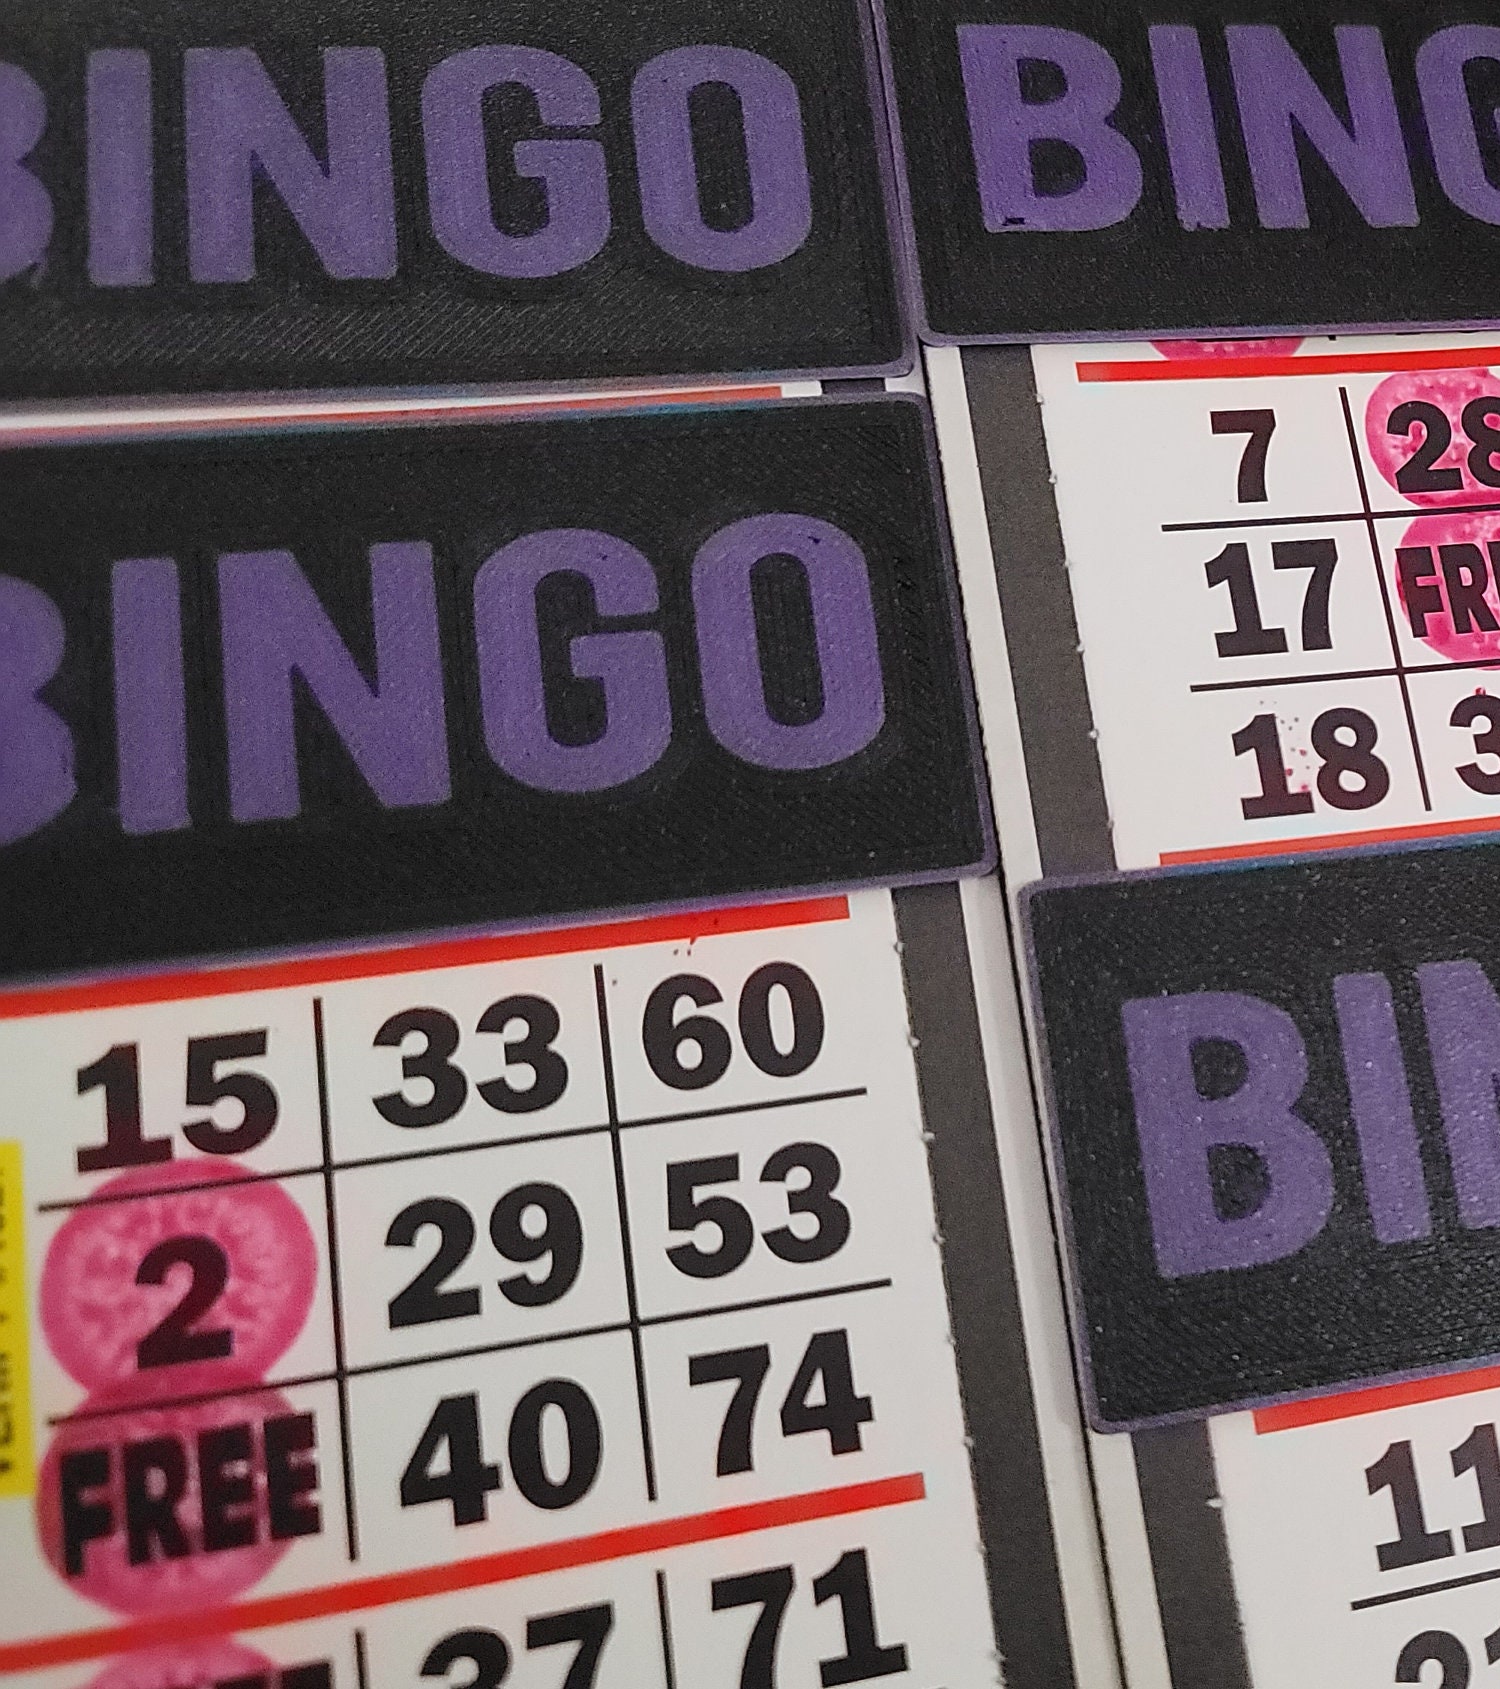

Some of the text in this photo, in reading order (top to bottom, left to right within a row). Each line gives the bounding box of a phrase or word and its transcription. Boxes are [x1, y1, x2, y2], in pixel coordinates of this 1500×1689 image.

[1211, 408, 1277, 503] 7
[1204, 538, 1338, 658] 17
[1230, 707, 1391, 820] 18
[75, 961, 825, 1173] 15 33 60
[135, 1234, 234, 1370] 2
[385, 1181, 584, 1329] 29
[666, 1142, 852, 1279] 53
[59, 1329, 874, 1579] FREE 40 74
[710, 1548, 910, 1689] 71
